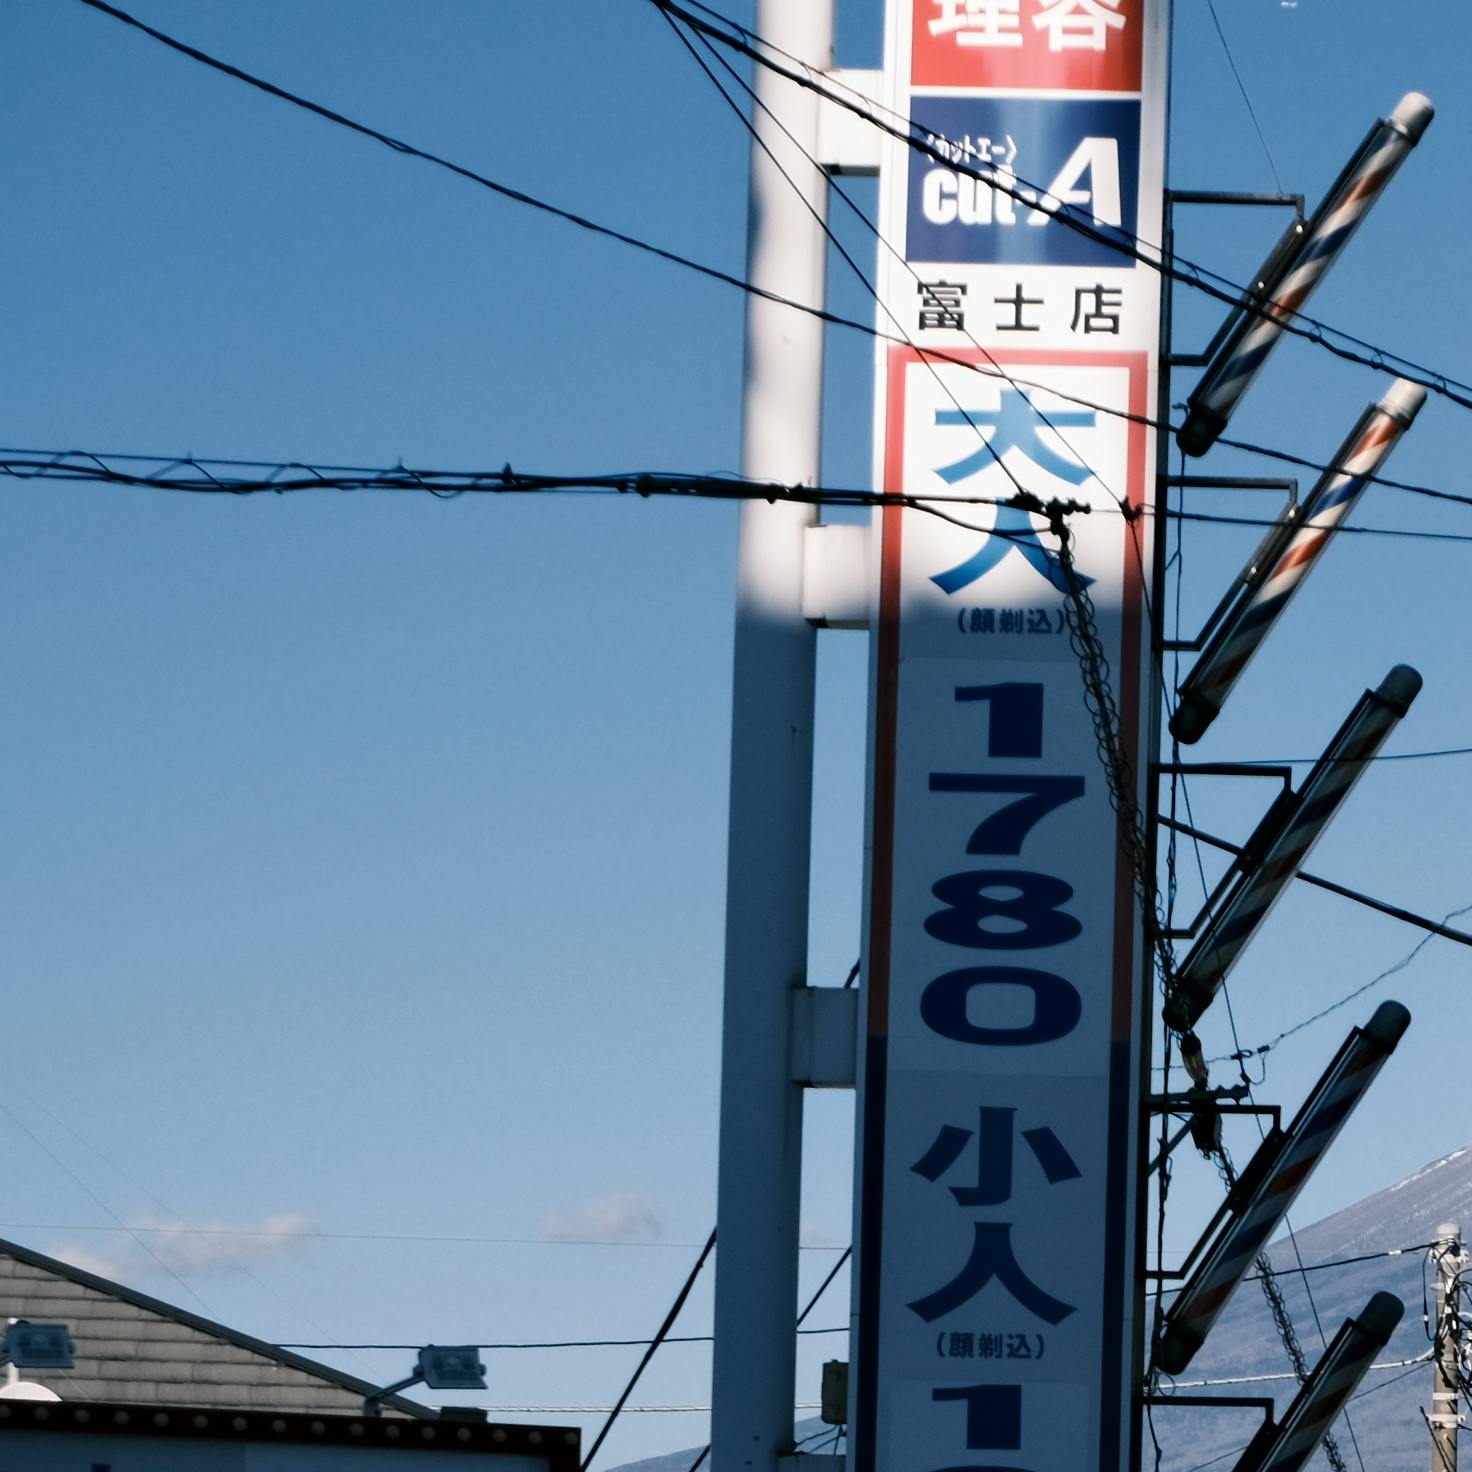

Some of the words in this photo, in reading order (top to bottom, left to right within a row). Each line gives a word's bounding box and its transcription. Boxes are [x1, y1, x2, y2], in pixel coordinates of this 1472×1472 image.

[916, 279, 1124, 335] 富士店
[928, 388, 1098, 596] 大人
[919, 681, 1086, 1047] 1780
[905, 1104, 1083, 1327] 小人
